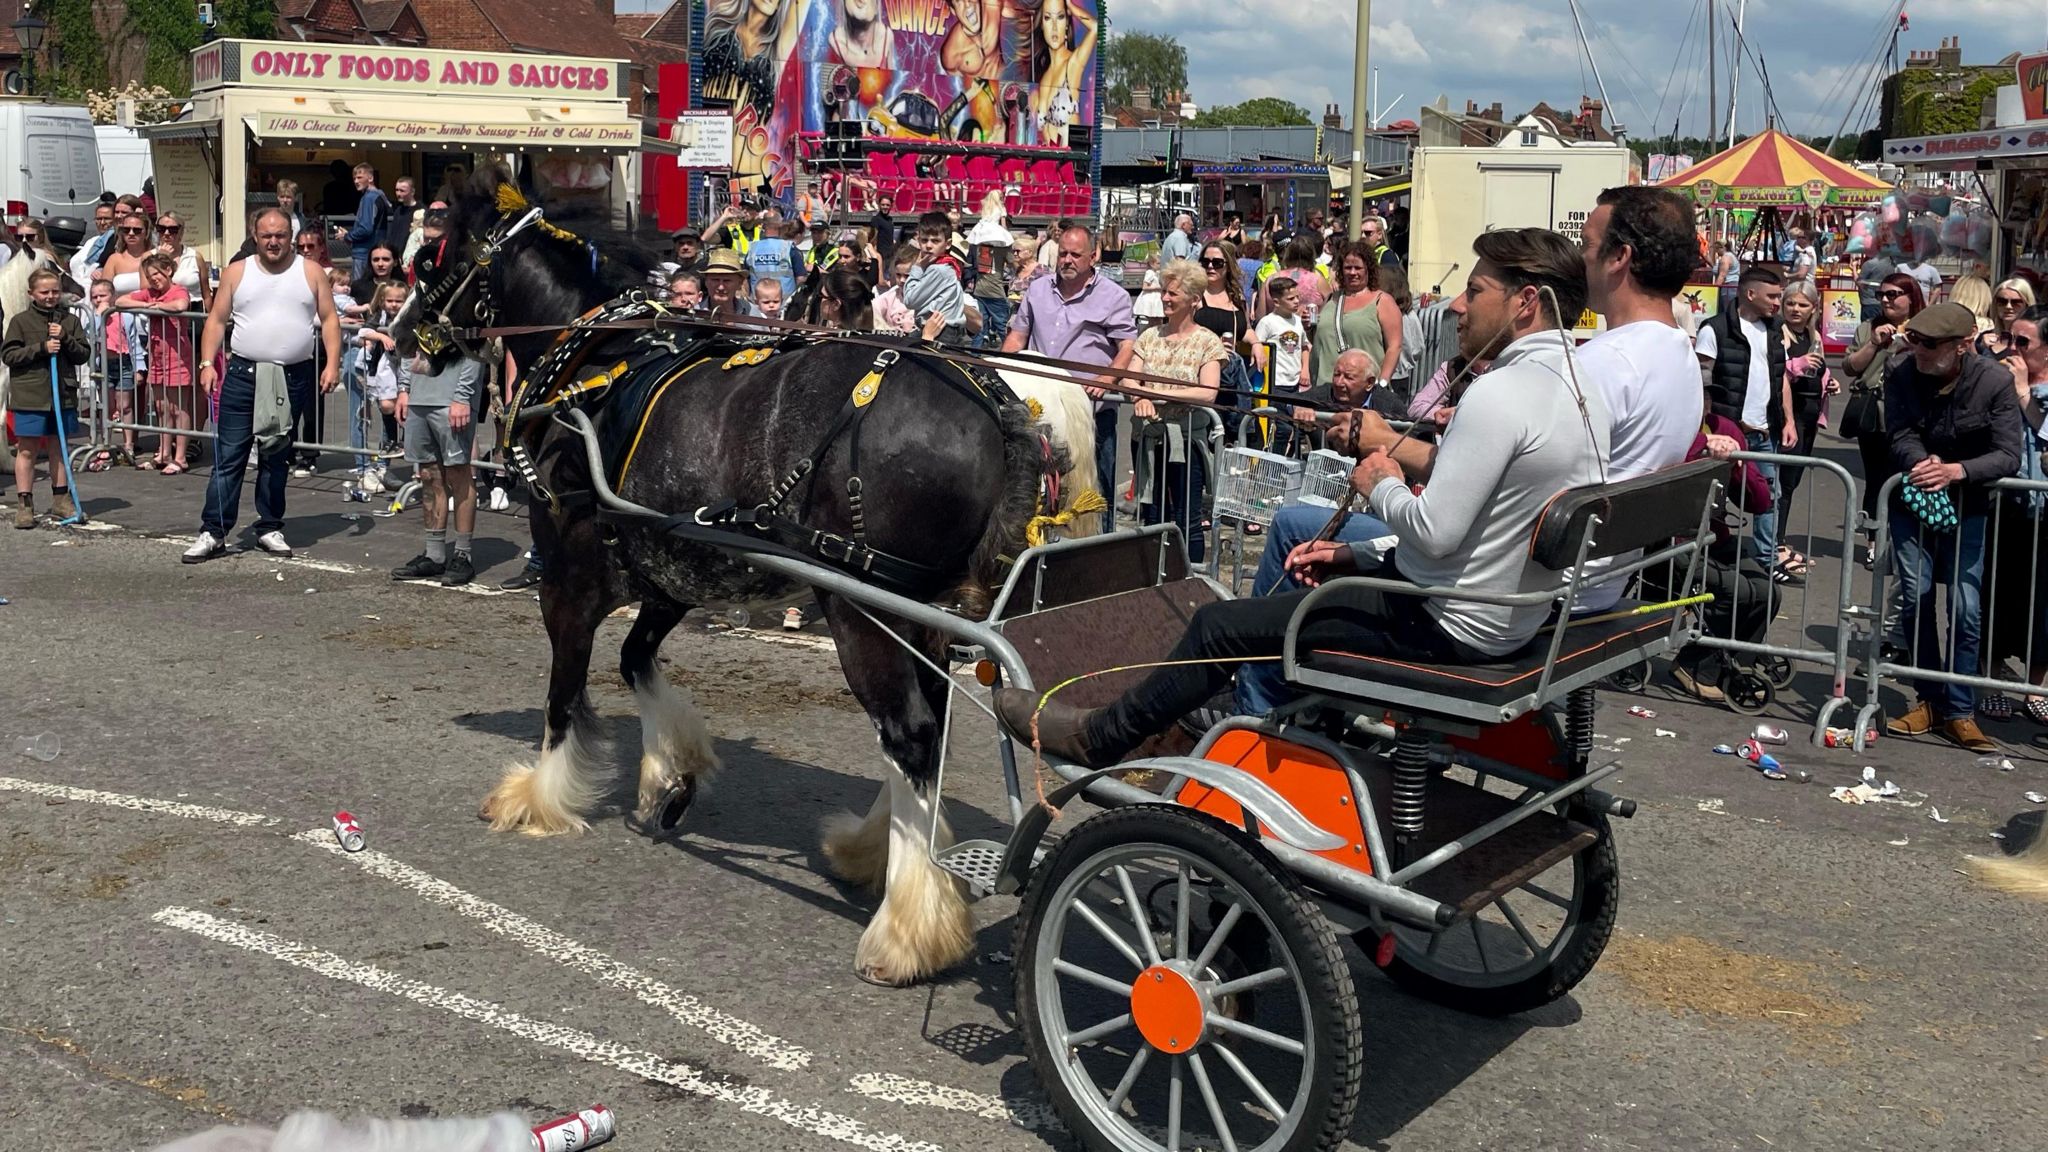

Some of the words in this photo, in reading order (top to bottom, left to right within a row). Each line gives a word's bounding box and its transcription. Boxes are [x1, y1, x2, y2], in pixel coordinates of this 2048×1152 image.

[251, 51, 332, 78] ONLY
[338, 55, 431, 83] FOODS
[439, 61, 499, 86] AND
[508, 63, 609, 91] SAUCES
[268, 119, 298, 131] 1/4lb
[302, 119, 340, 132] Cheese
[552, 128, 565, 138] &
[569, 128, 593, 139] Cold
[598, 128, 633, 140] Drinks
[735, 103, 793, 198] ROCK
[1925, 135, 2002, 155] BURGERS
[1568, 211, 1585, 221] FOR
[755, 254, 779, 263] POLICE
